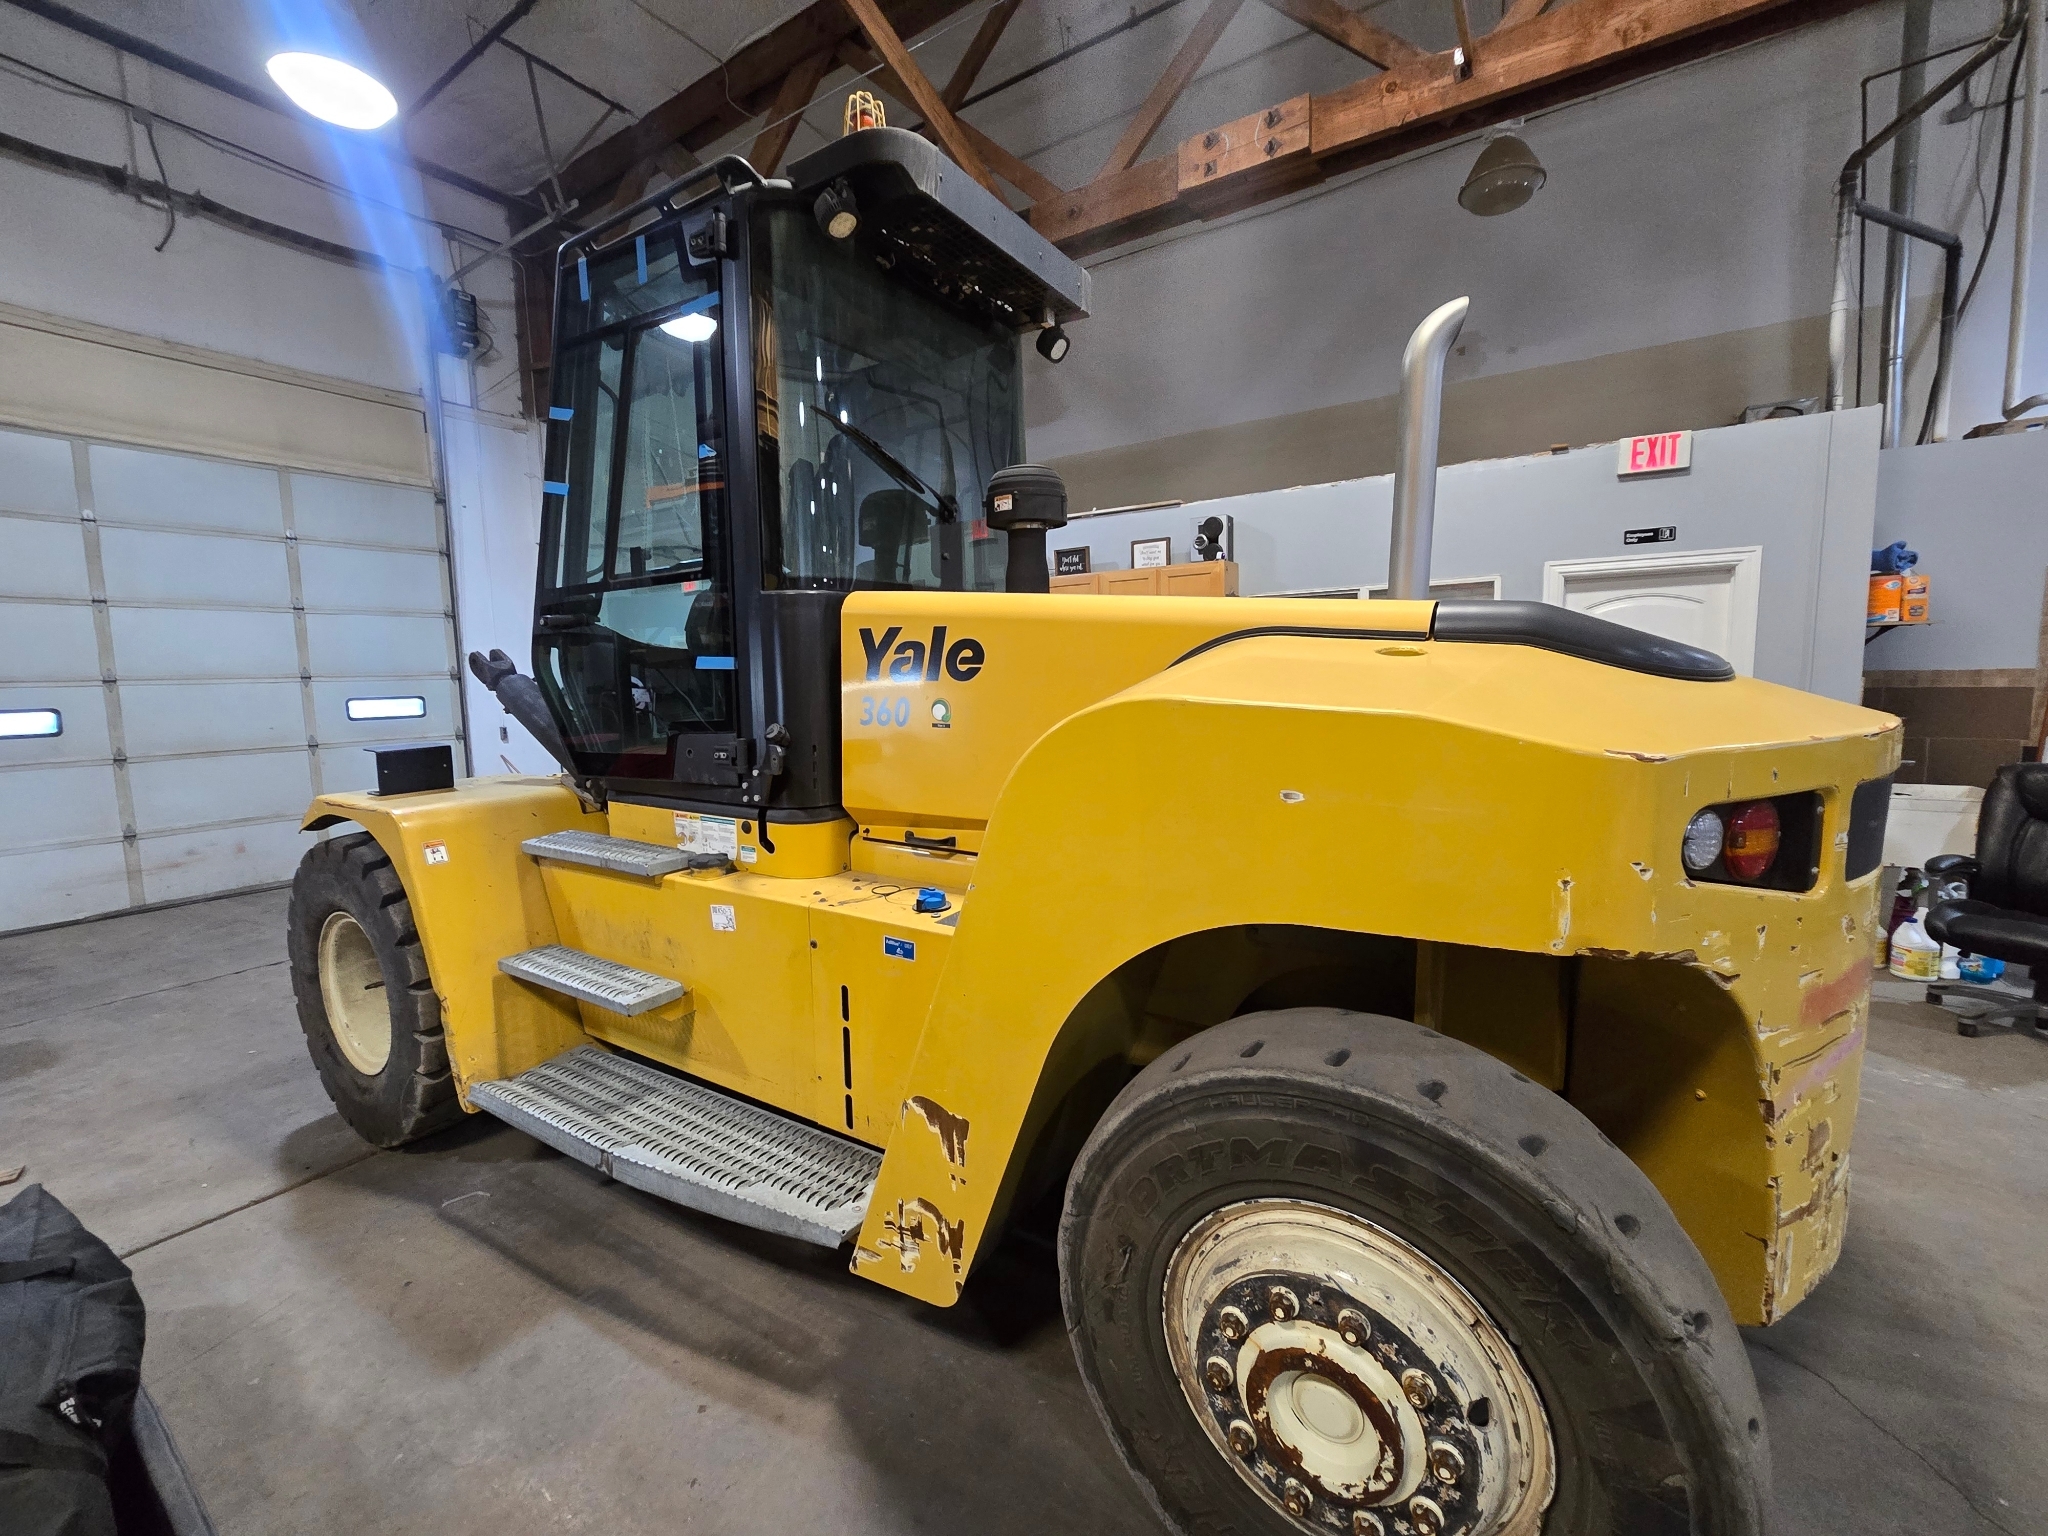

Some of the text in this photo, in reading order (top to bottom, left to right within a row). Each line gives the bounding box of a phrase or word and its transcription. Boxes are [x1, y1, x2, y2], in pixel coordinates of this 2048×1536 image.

[1630, 433, 1682, 471] EXIT
[859, 625, 985, 682] Yale
[860, 695, 910, 728] 360
